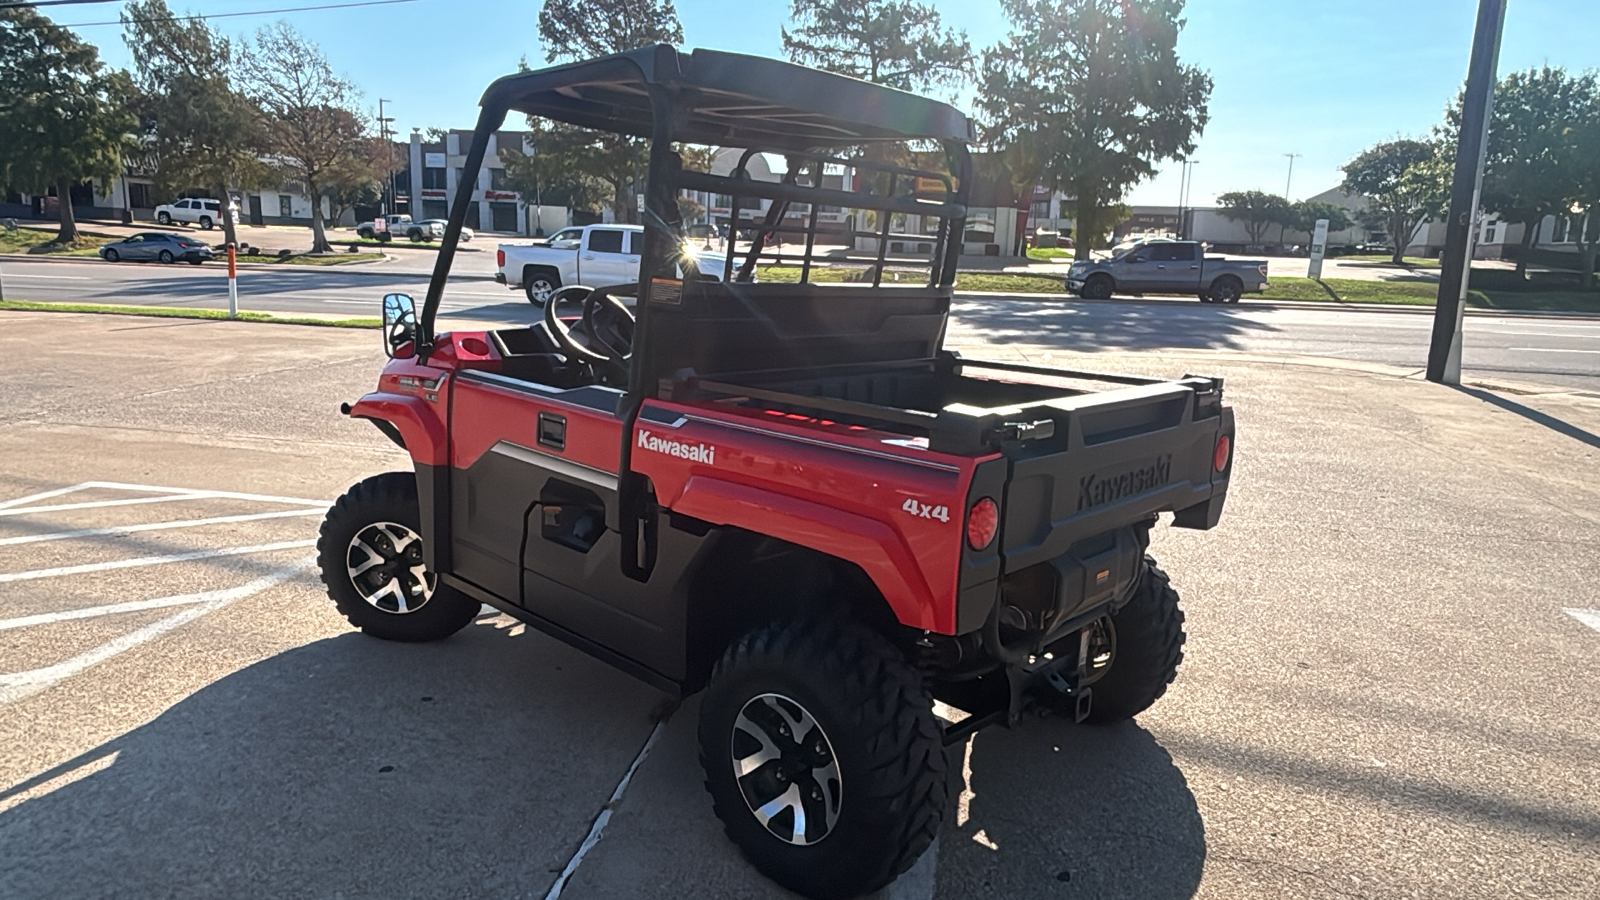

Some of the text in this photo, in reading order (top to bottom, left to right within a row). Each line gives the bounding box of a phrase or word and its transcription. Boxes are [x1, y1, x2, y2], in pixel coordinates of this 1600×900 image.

[637, 429, 715, 465] Kawasaki
[1077, 453, 1173, 511] Kawasaki
[902, 498, 950, 523] 4x4
